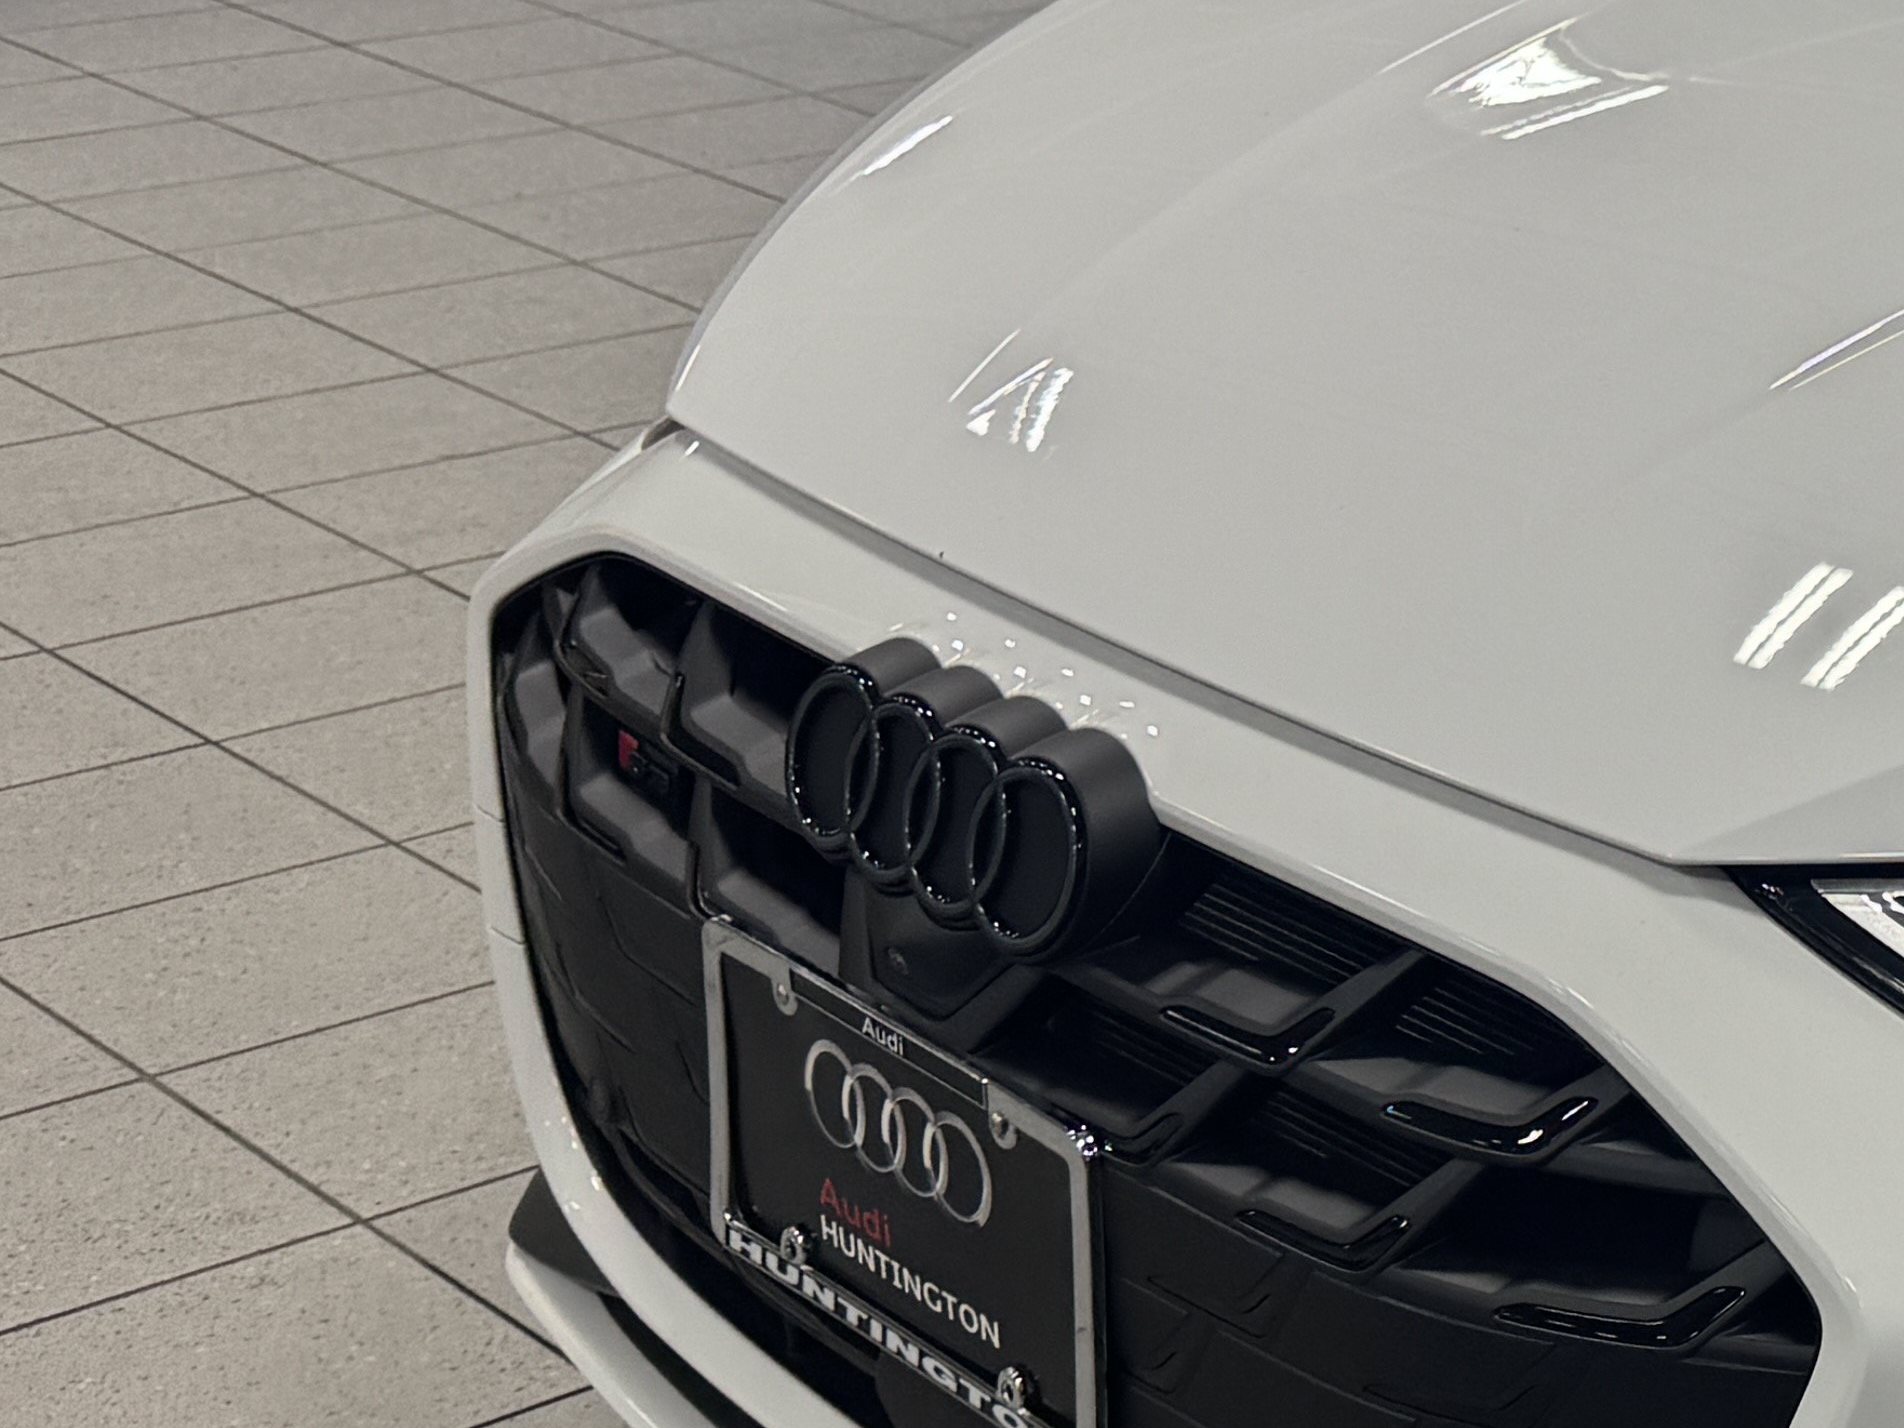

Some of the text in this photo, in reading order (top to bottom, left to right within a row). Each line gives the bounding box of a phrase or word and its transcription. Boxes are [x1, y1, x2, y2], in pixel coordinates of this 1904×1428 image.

[861, 1016, 905, 1057] Audi
[819, 1177, 892, 1248] Audi
[820, 1214, 1001, 1350] HUNTINGTON
